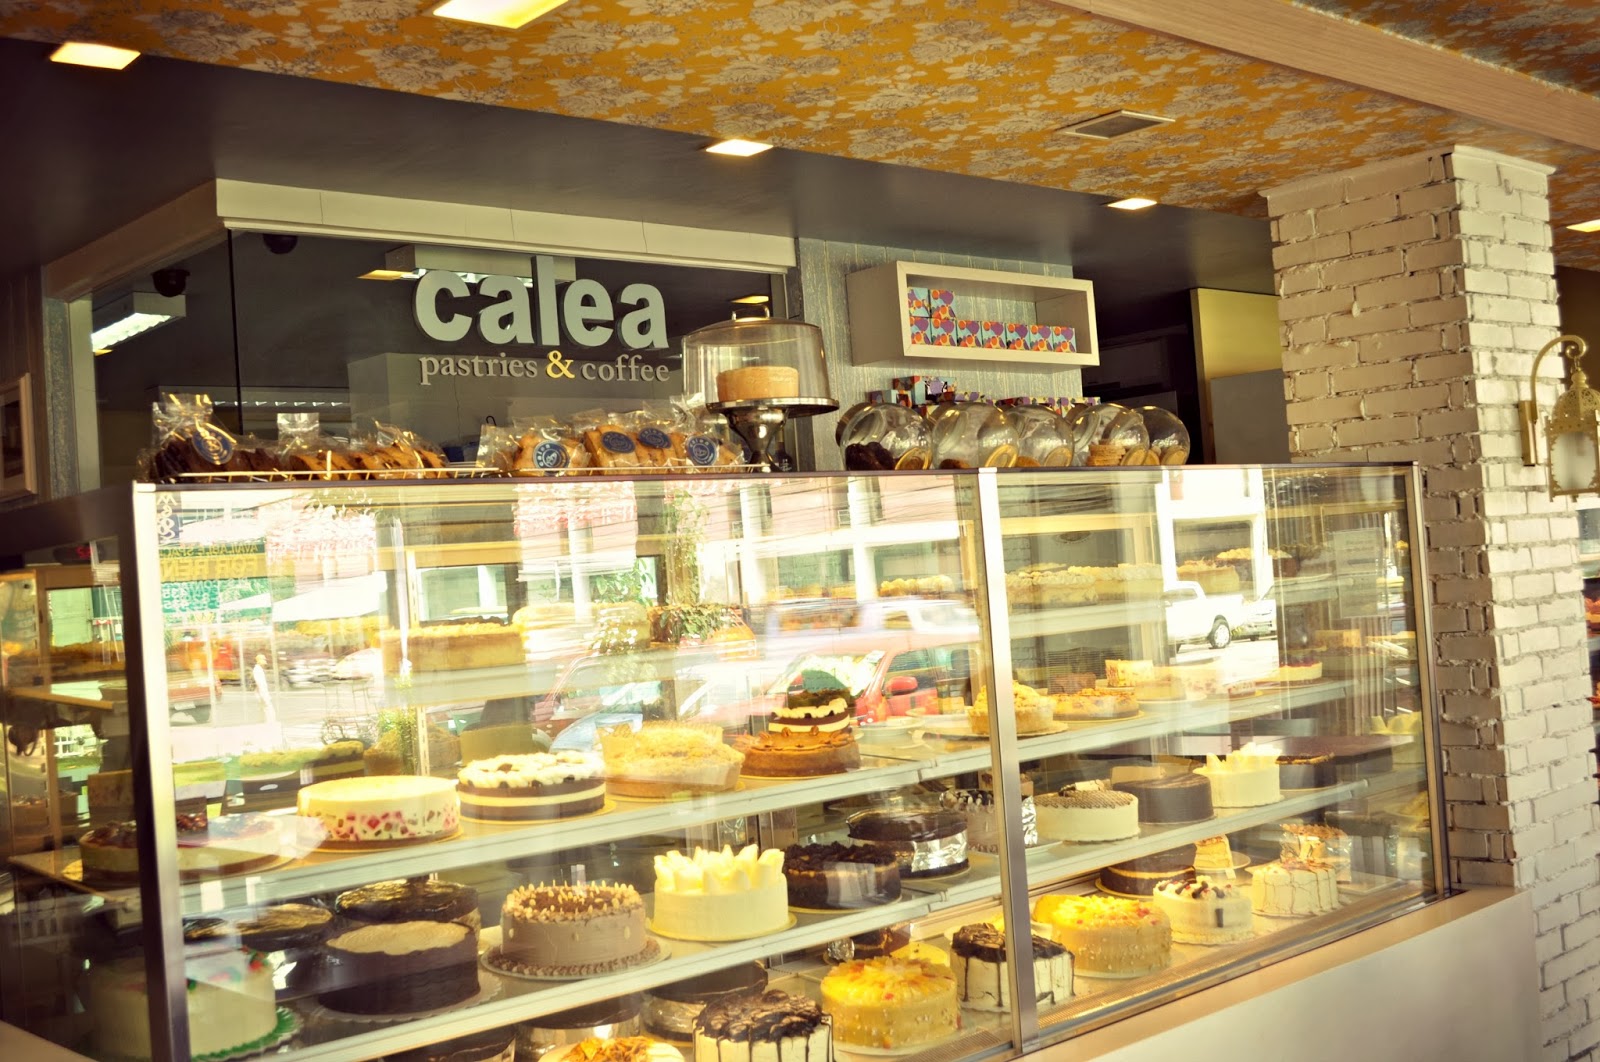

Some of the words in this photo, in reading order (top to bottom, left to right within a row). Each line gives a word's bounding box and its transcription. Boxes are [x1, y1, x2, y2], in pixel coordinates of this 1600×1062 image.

[413, 255, 669, 350] calea
[419, 352, 538, 386] pastries
[546, 350, 576, 380] &
[581, 354, 670, 382] coffee
